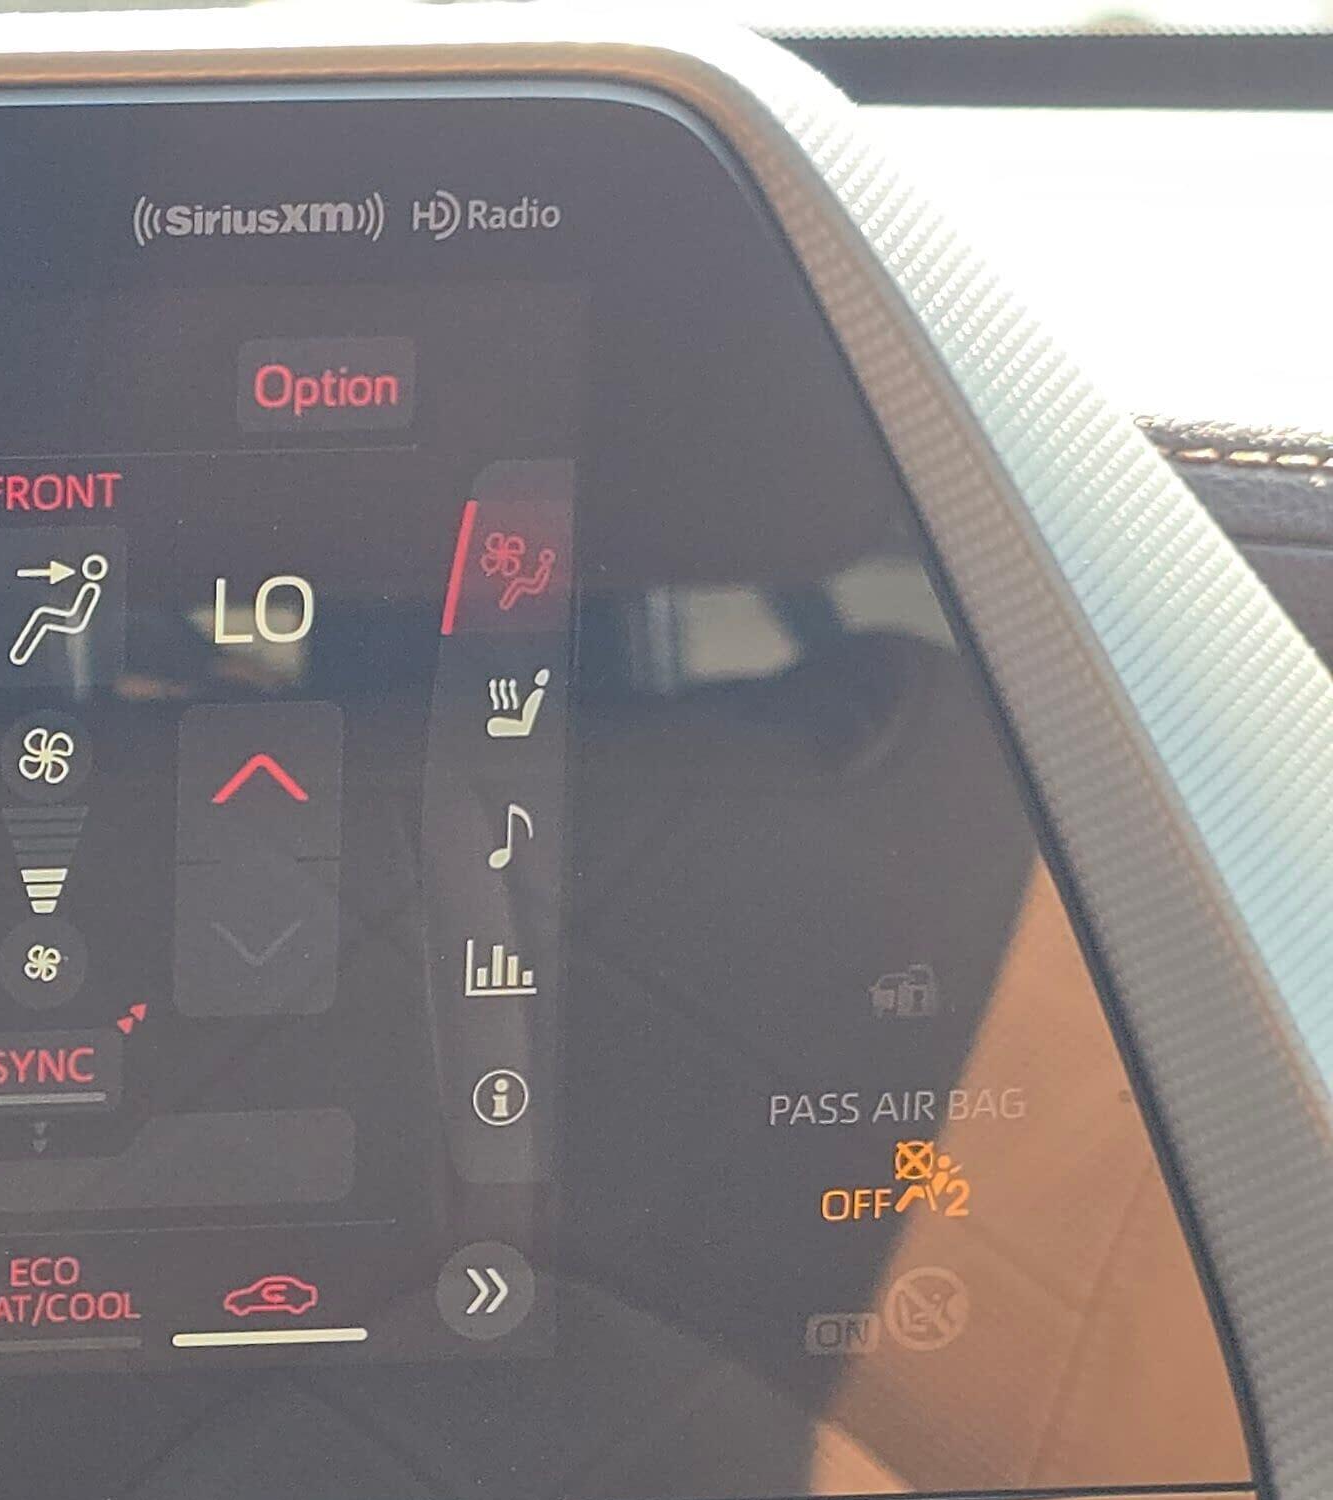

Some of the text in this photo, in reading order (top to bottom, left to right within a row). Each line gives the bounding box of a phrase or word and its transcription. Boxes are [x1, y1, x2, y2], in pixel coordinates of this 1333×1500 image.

[467, 198, 561, 231] Radio
[253, 364, 399, 417] Option
[214, 575, 316, 645] LO
[769, 1087, 1026, 1126] PASS AIR BAG
[820, 1187, 893, 1223] OFF
[9, 1255, 81, 1288] ECO
[815, 1318, 870, 1349] ON
